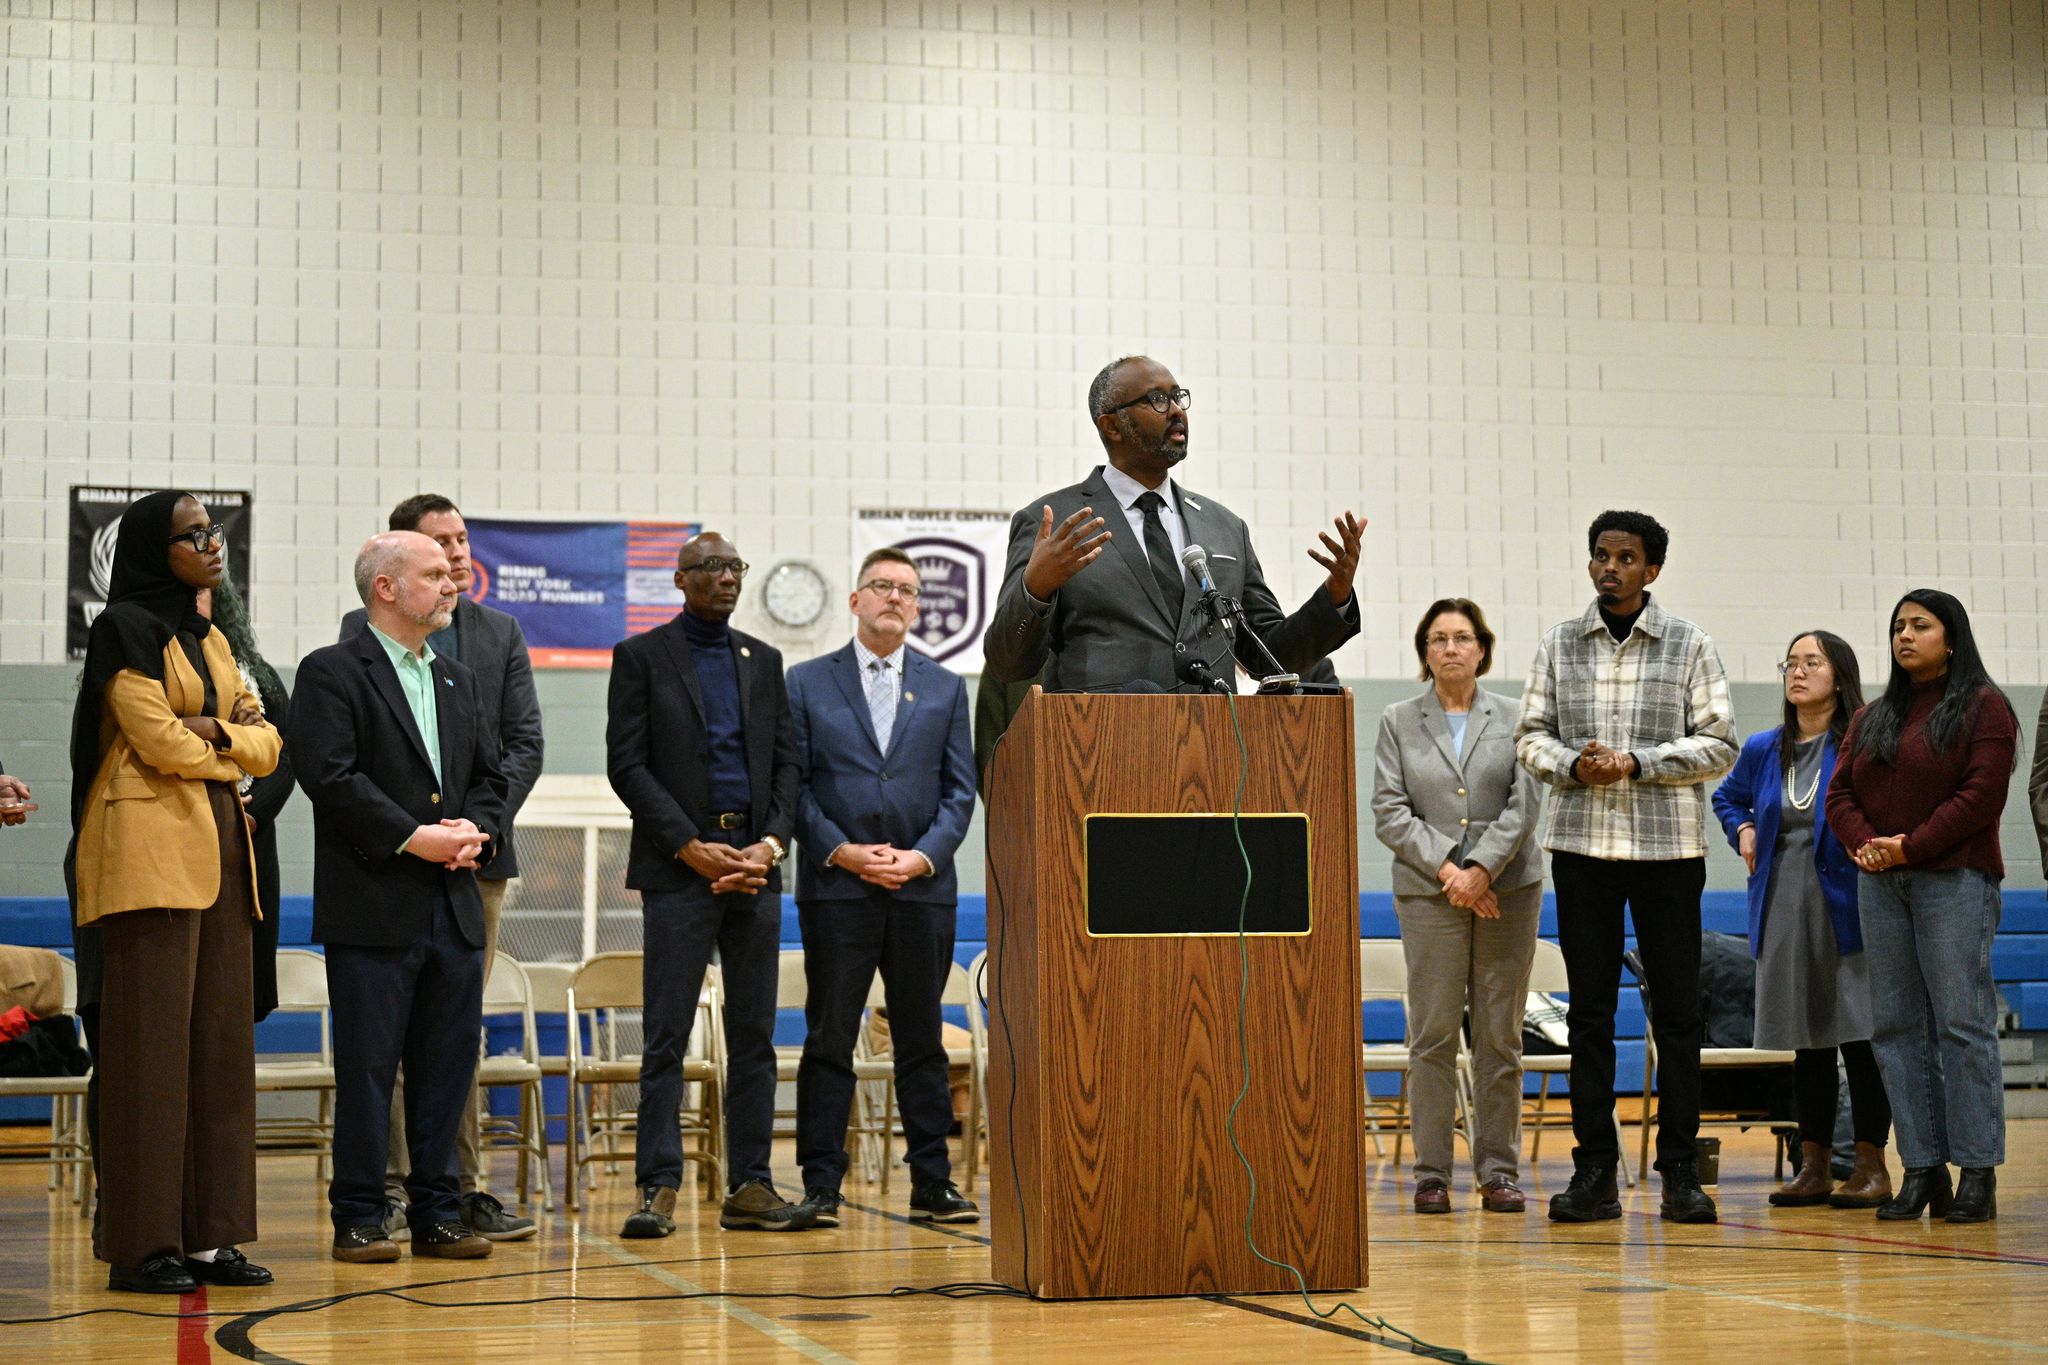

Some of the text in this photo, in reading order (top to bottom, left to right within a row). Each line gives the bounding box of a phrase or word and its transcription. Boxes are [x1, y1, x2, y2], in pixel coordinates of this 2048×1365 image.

[78, 488, 128, 503] BRIAN
[497, 578, 572, 591] NEW YORK
[497, 590, 538, 602] ROAD
